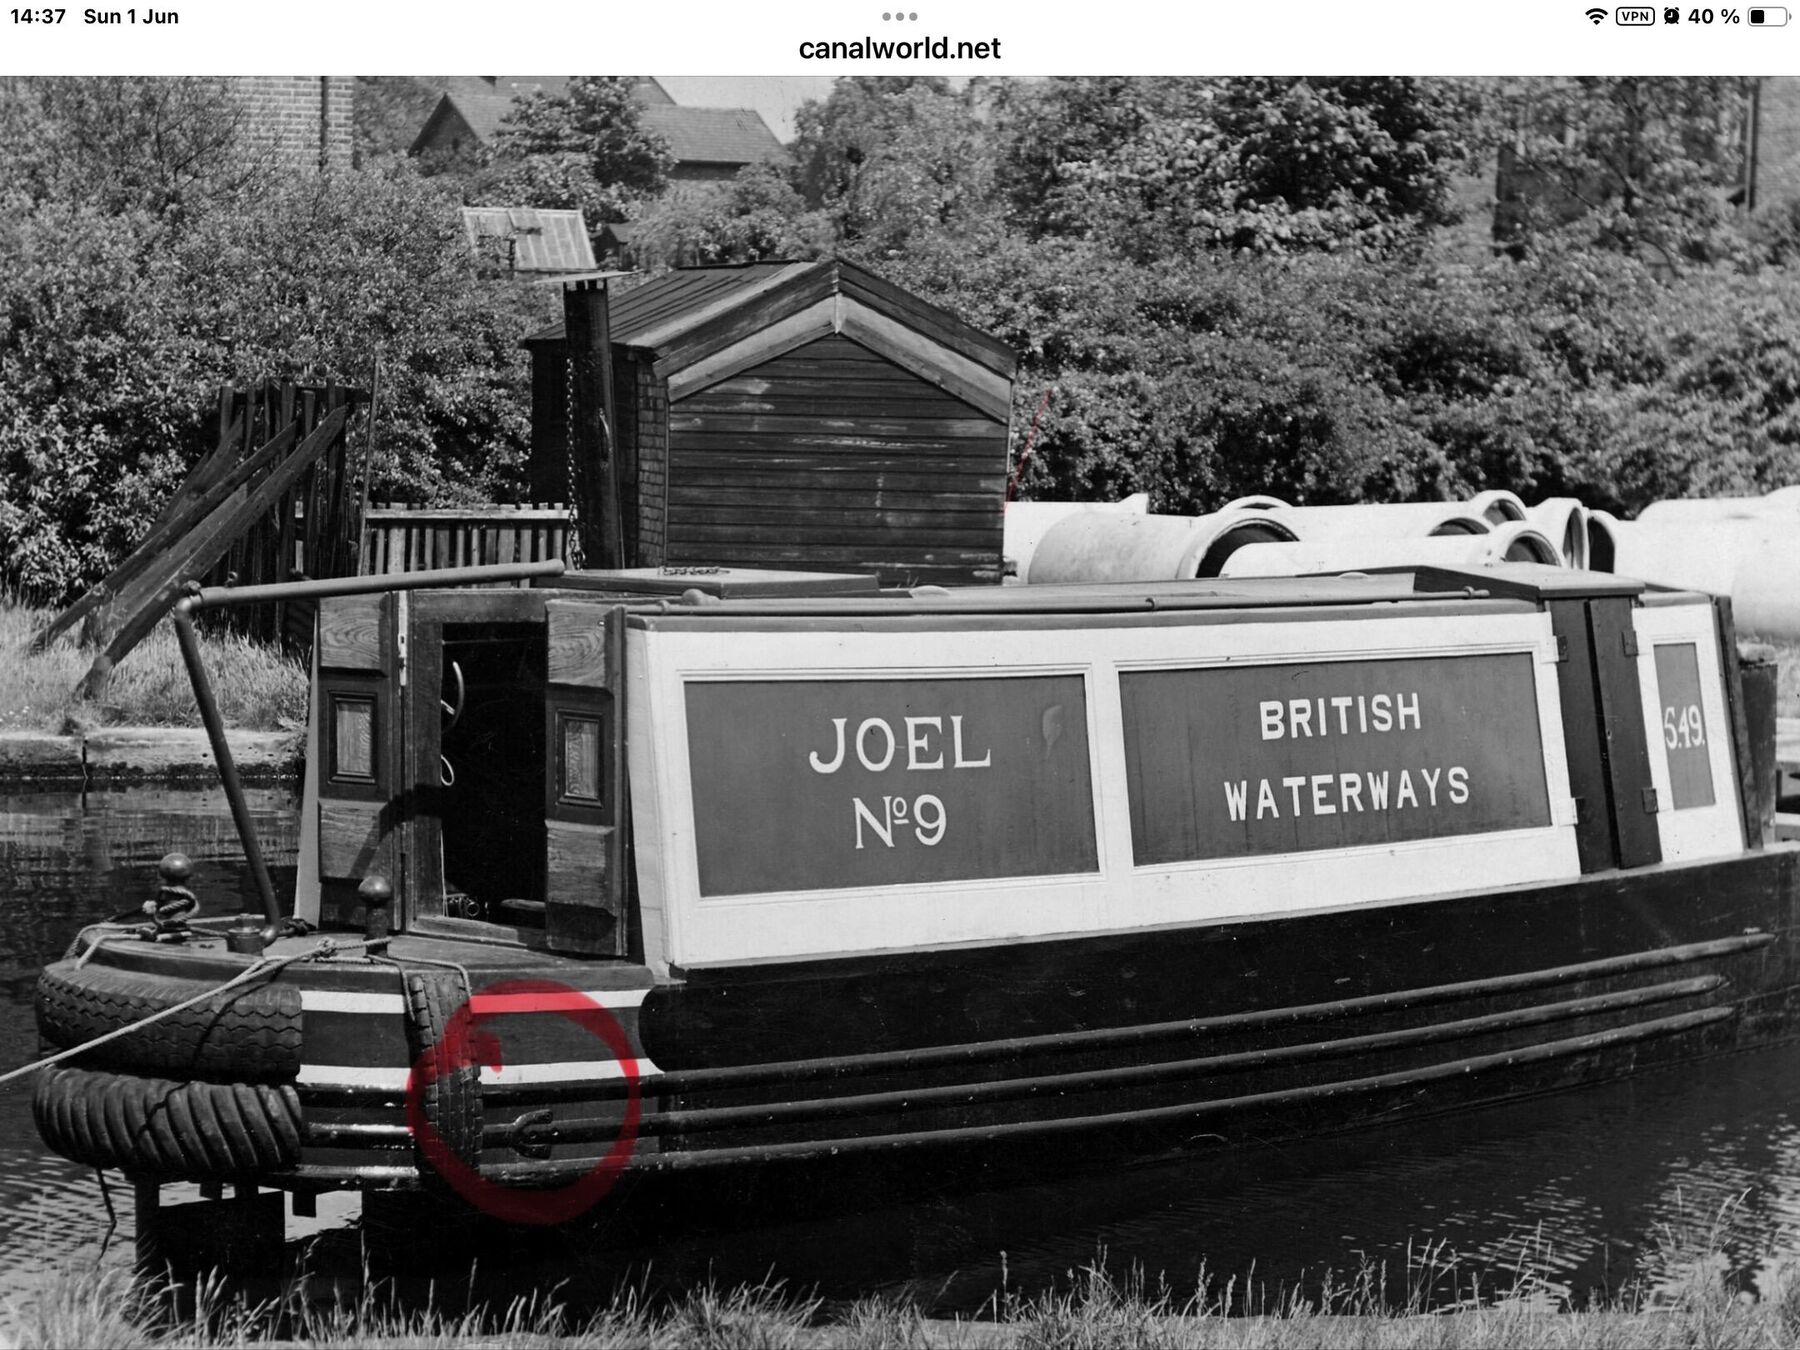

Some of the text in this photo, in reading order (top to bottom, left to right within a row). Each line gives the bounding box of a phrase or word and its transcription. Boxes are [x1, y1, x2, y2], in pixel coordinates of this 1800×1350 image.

[1259, 692, 1422, 740] BRITISH
[809, 715, 991, 774] JOEL
[1223, 766, 1470, 822] WATERWAYS
